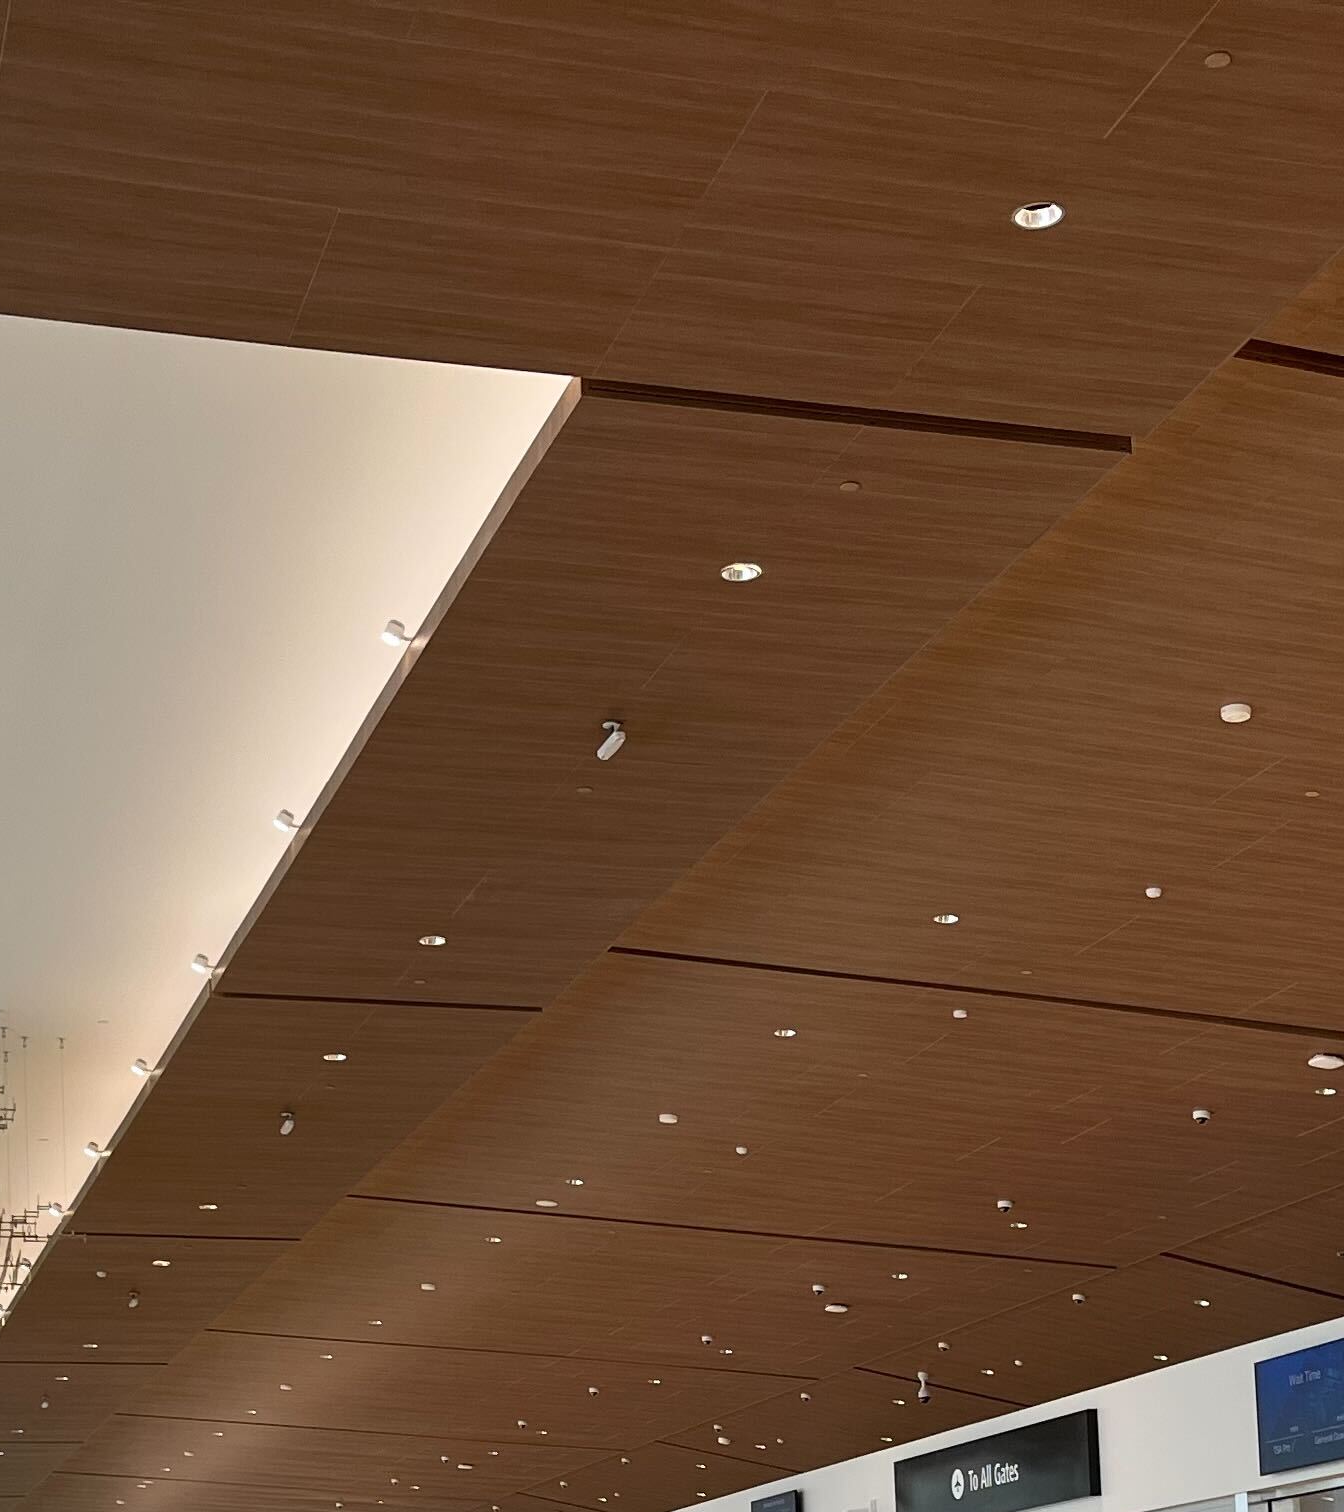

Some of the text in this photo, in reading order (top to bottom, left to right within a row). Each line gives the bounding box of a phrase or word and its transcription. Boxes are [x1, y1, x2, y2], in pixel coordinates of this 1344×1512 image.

[968, 1462, 1019, 1492] To All Gates
